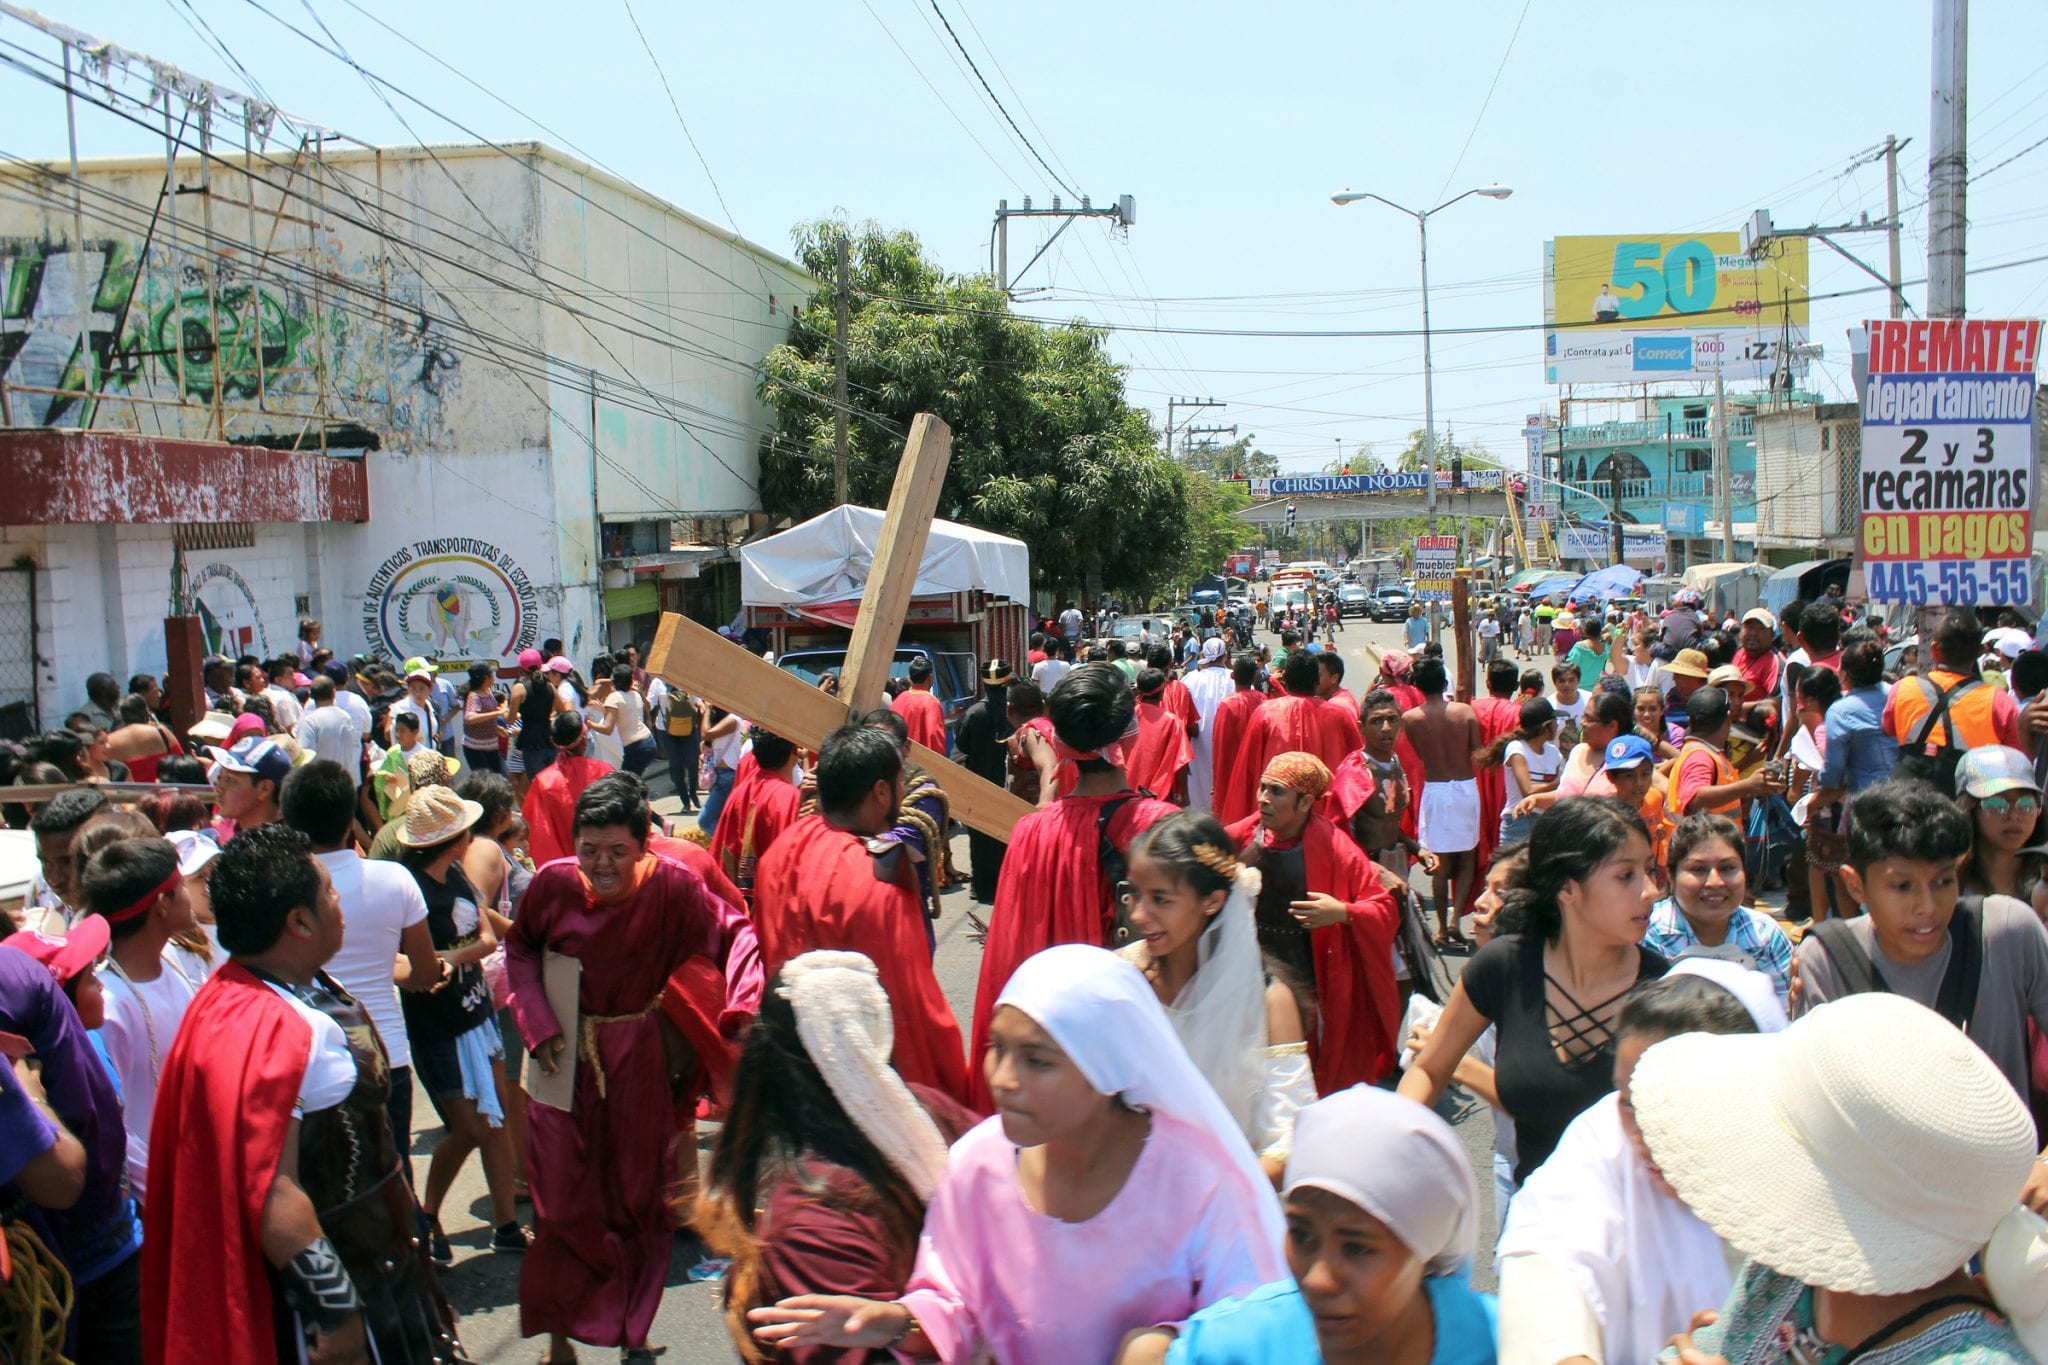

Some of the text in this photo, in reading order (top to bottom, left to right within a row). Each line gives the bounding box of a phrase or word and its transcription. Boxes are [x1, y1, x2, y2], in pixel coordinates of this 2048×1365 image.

[1611, 240, 1717, 318] 50
[1563, 347, 1607, 358] ¡Contrata
[1637, 346, 1688, 360] Comex
[1870, 321, 2040, 372] ¡REMATE!
[1867, 377, 2030, 424] departamento
[1900, 427, 1994, 465] 2 y 3
[1272, 473, 1427, 493] CHRISTIAN NODAL
[1862, 469, 2026, 511] recamaras
[1528, 505, 1545, 518] 24
[1417, 537, 1457, 549] ¡REMATE!
[1863, 513, 2026, 560] en pagos
[362, 601, 379, 613] DE
[413, 537, 501, 562] TRANSPORTISTAS
[498, 553, 513, 574] DEL
[509, 567, 535, 600] ESTADO
[522, 601, 538, 612] DE
[1416, 561, 1455, 570] muebles
[1871, 559, 2028, 605] 445-55-55
